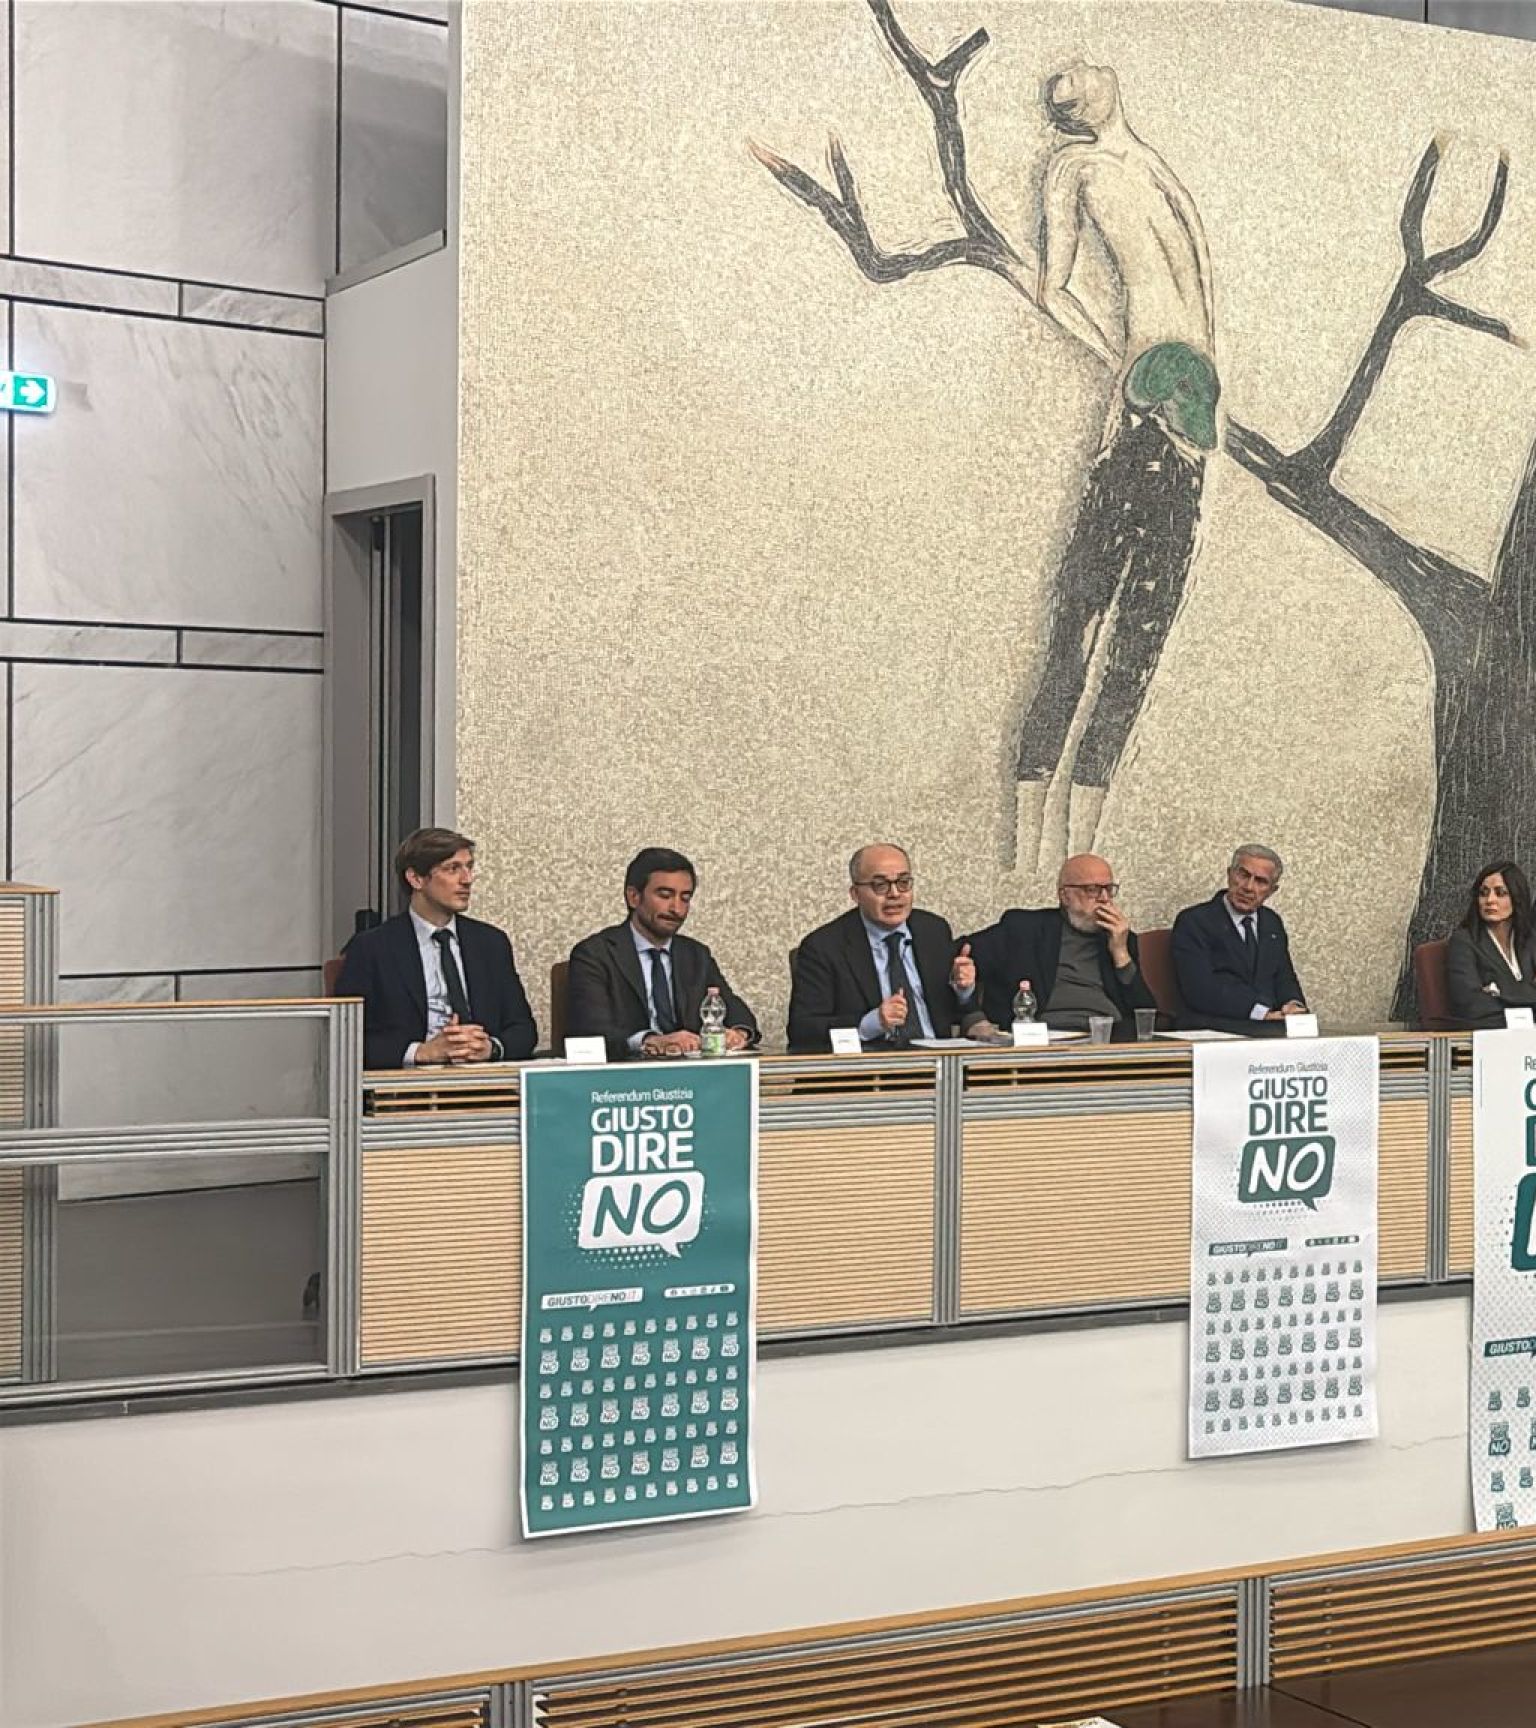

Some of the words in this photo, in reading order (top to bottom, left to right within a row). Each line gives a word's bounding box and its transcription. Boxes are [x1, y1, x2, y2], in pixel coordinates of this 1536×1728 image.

[592, 1090, 650, 1103] Referendum
[653, 1088, 693, 1100] Giustizia
[1249, 1077, 1327, 1100] GIUSTO
[591, 1104, 693, 1132] GIUSTO
[1249, 1100, 1328, 1136] DIRE
[593, 1131, 693, 1173] DIRE
[1248, 1142, 1325, 1193] NO
[593, 1180, 690, 1237] NO
[1490, 1441, 1508, 1453] NO
